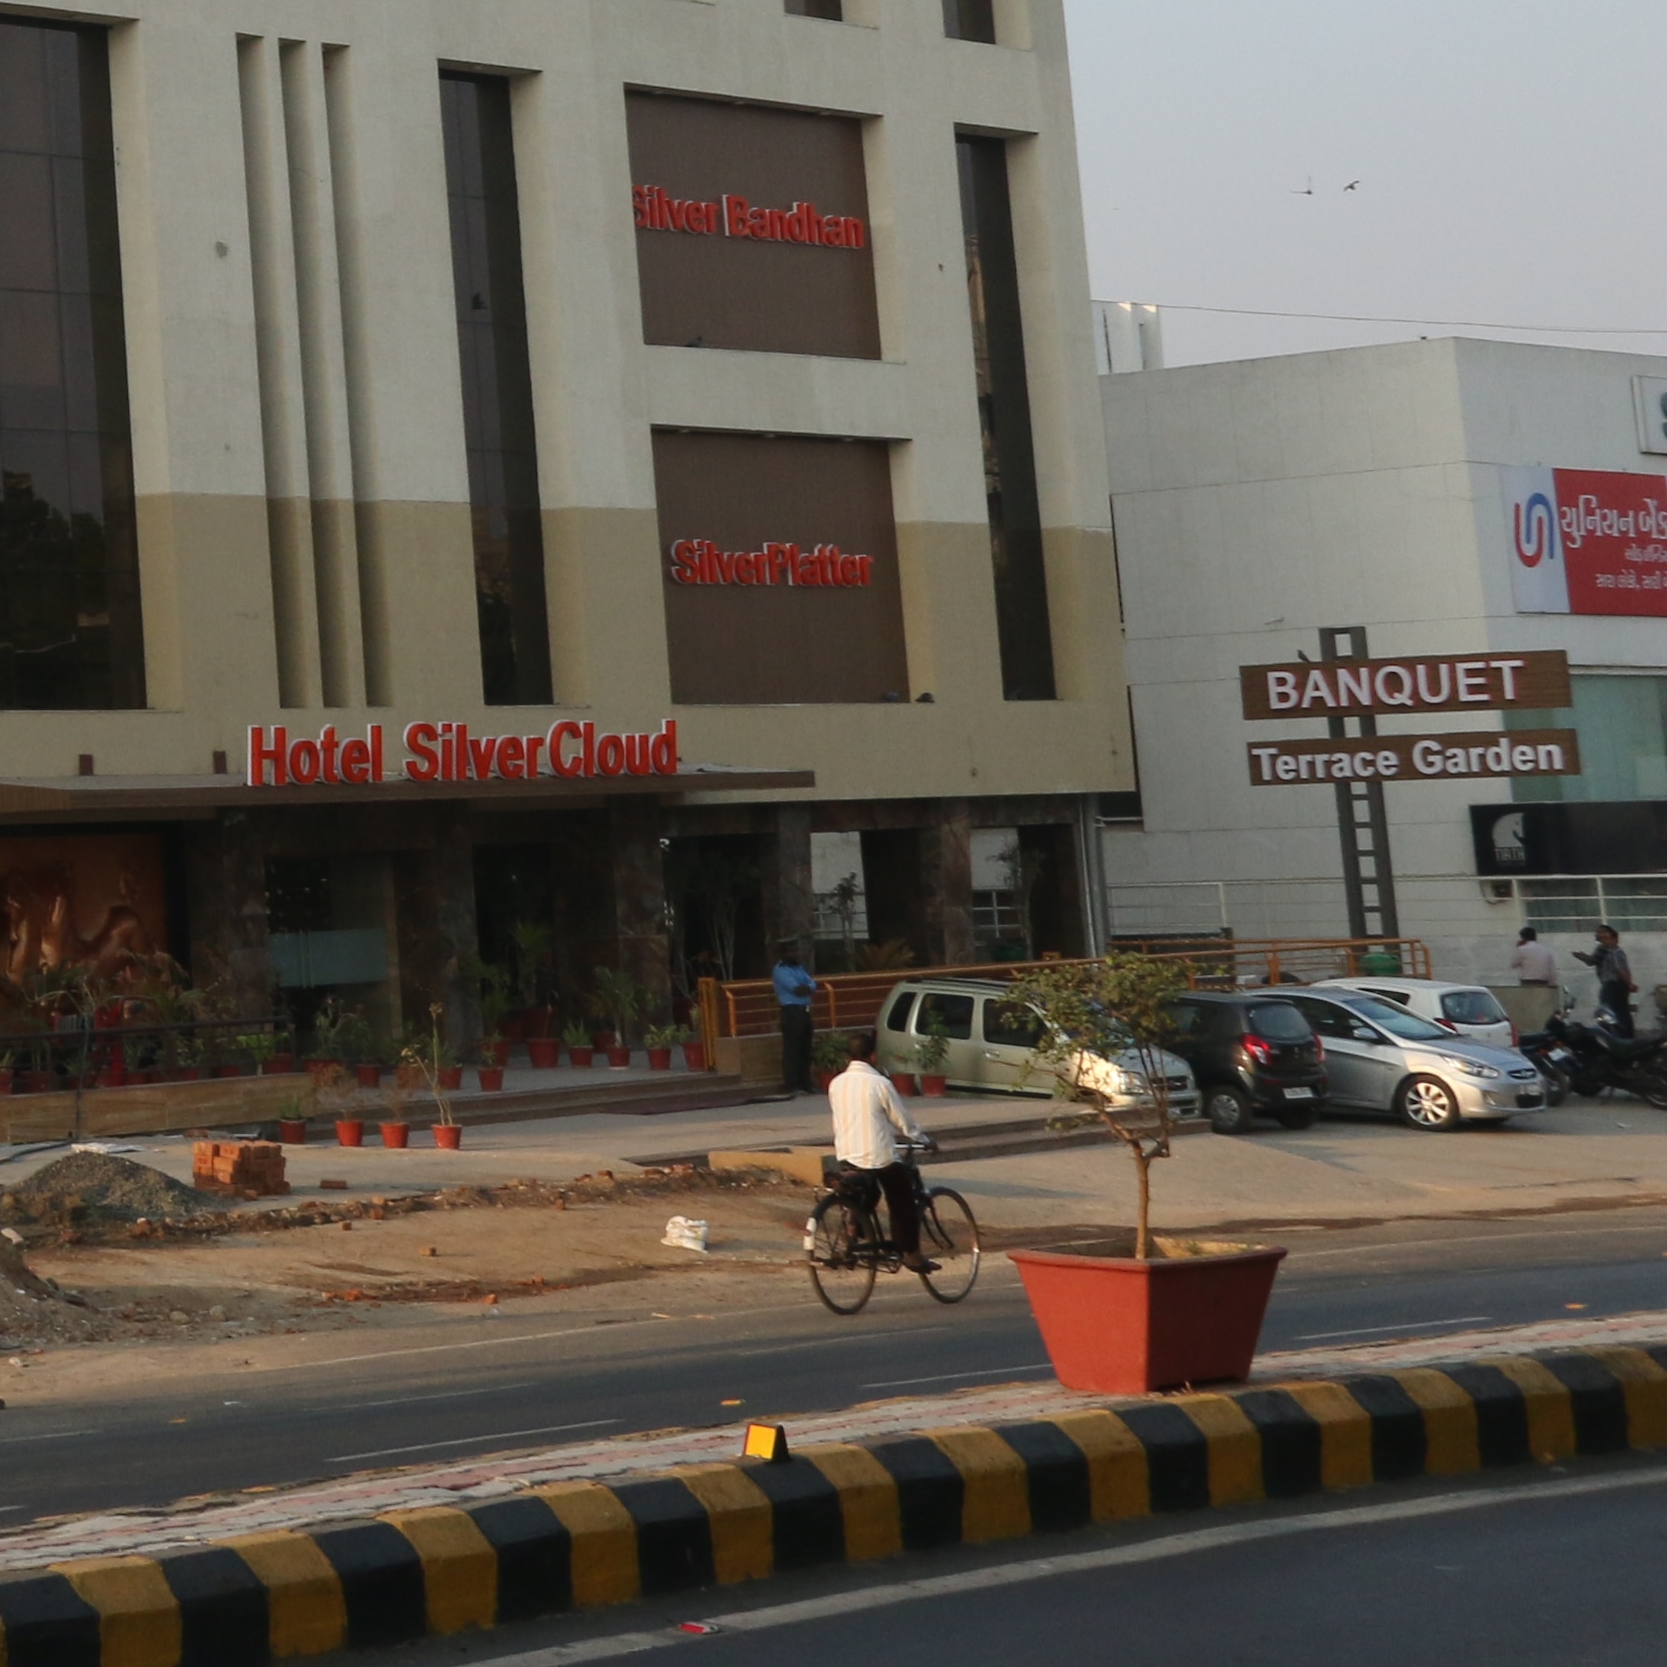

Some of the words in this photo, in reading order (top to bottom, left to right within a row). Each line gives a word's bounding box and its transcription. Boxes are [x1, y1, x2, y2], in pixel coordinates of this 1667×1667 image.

[632, 184, 720, 235] Silver
[722, 194, 865, 248] Bandhan
[1561, 494, 1636, 549] યુનિયન
[1267, 660, 1525, 710] BANQUET
[247, 724, 383, 786] Hotel
[1252, 746, 1399, 781] Terrace
[1412, 738, 1565, 776] Garden
